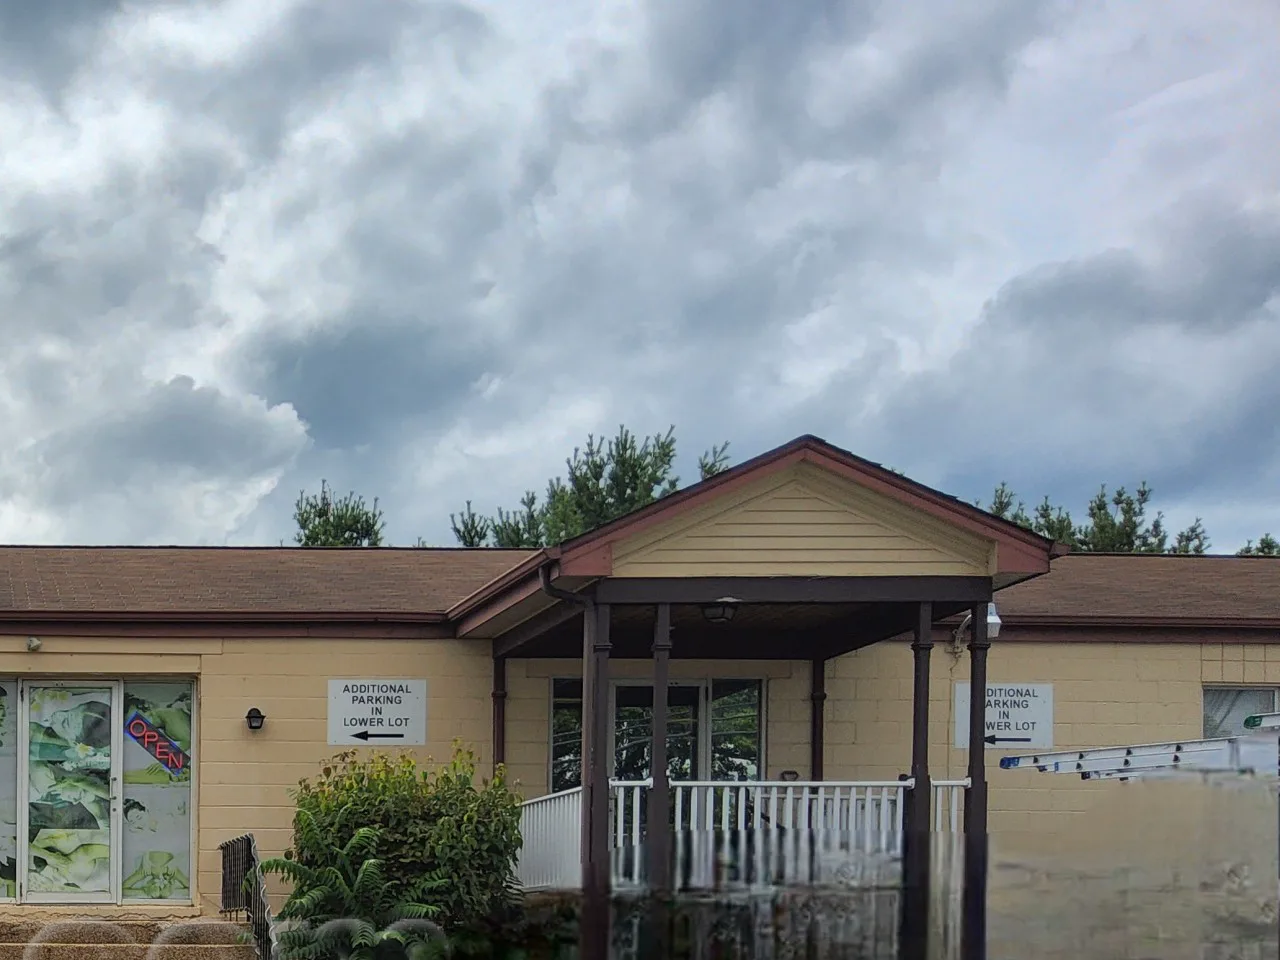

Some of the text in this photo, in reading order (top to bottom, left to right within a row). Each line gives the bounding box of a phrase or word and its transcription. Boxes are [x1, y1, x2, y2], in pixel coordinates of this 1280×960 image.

[342, 684, 412, 694] ADDITIONAL
[986, 687, 1039, 698] DITIONAL
[351, 695, 403, 705] PARKING
[985, 699, 1030, 709] ARKING
[371, 706, 383, 716] IN
[998, 710, 1010, 720] IN
[343, 717, 410, 727] LOWER LOT
[985, 721, 1037, 731] WER LOT
[129, 719, 184, 769] OPEN
